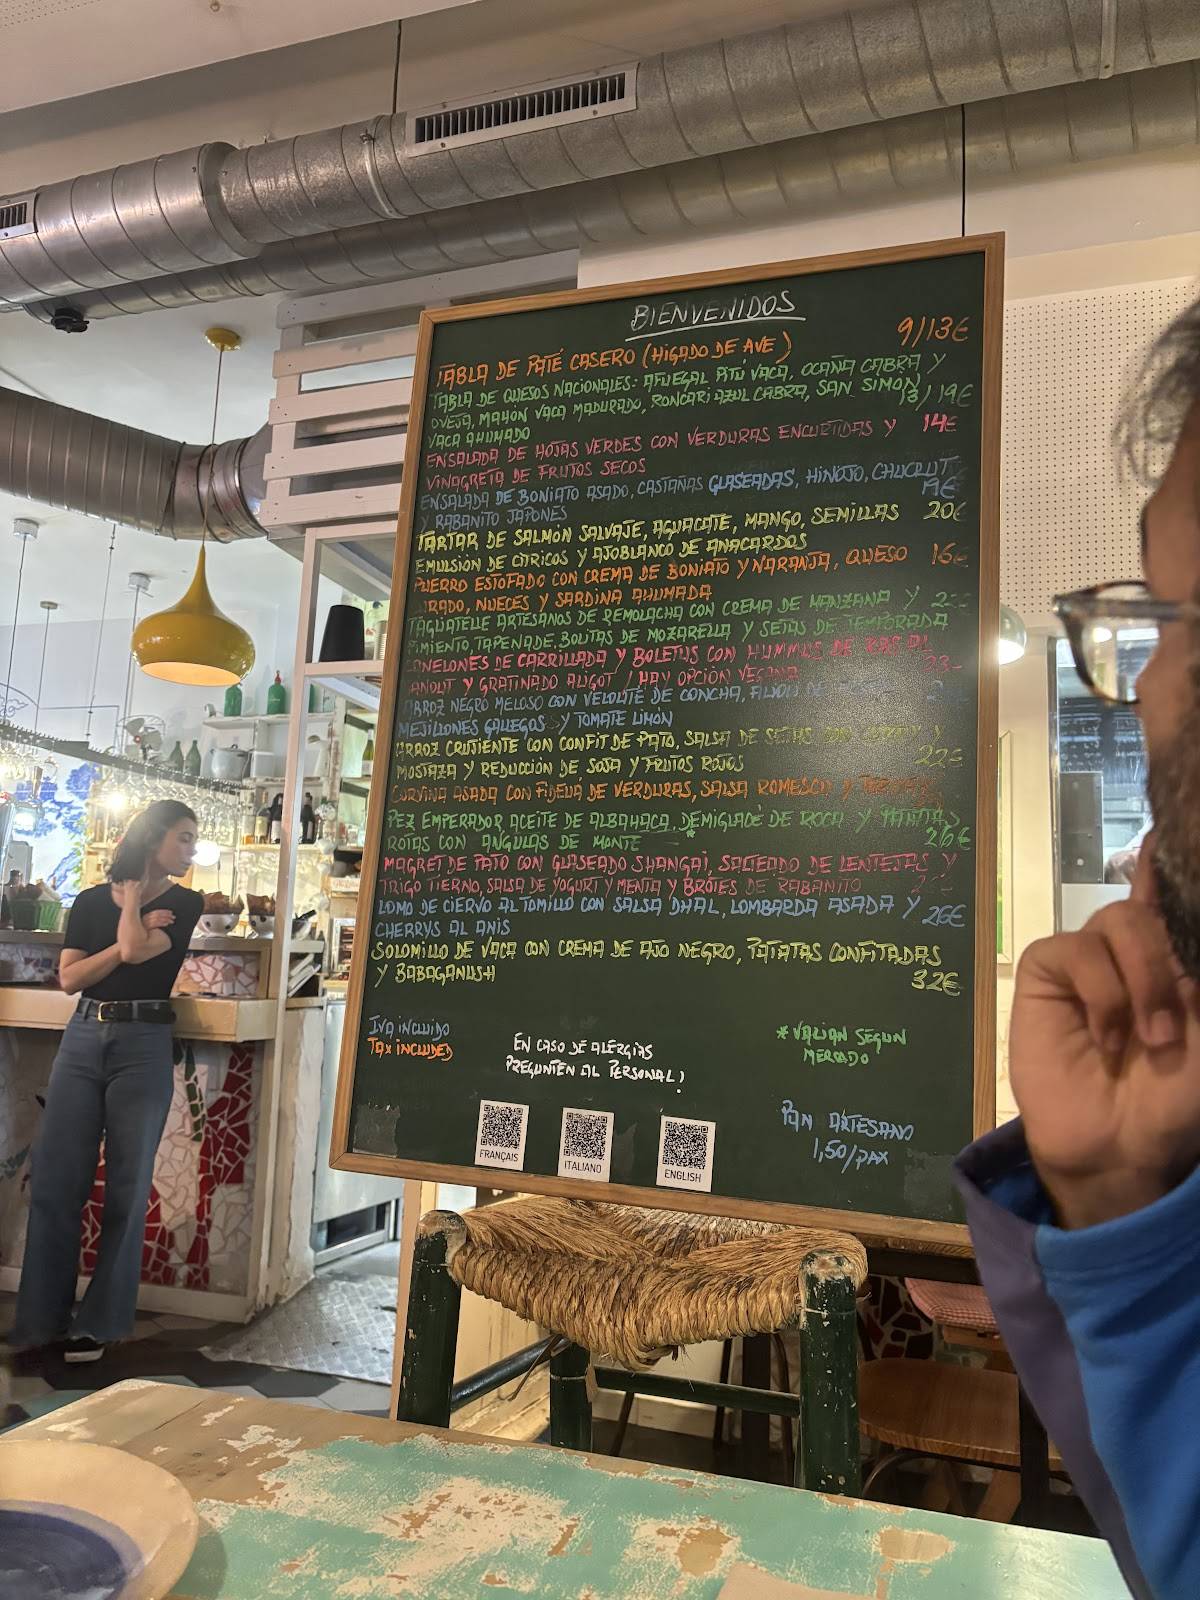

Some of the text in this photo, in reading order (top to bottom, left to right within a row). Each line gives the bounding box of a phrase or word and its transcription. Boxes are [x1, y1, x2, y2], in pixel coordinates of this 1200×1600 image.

[631, 290, 796, 331] BIENVENIDOS
[437, 364, 489, 390] TABLA
[496, 360, 520, 380] DE
[569, 349, 635, 371] CASERO
[711, 338, 740, 359] DE
[430, 391, 472, 413] TABLA
[476, 389, 499, 407] DE
[503, 384, 549, 402] QUESOS
[860, 353, 921, 376] CABRA
[927, 352, 946, 374] Y
[535, 403, 567, 420] VACA
[816, 379, 853, 397] SAN
[427, 426, 770, 469] ENSALADA DE HOJAS VERDES CON VERDURAS
[428, 427, 530, 450] VACA AHUMADO
[427, 458, 646, 492] VINAGRETA DE FRUTOS SECOS
[420, 492, 489, 511] ENSALADA
[495, 488, 516, 505] DE
[518, 485, 580, 505] BONIATO
[416, 530, 478, 553] TARTAR
[486, 530, 507, 549] DE
[811, 502, 900, 525] SEMILLAS
[435, 510, 499, 531] RABANITO
[487, 533, 807, 573] DE AJOBLANCO DE ANACARDOS
[414, 545, 908, 593] PUERRO ESTOFADO CON CREMA DE BONIATO QUESO
[476, 584, 713, 612] NUECES SARDINA AHUMADA
[497, 610, 572, 635] ARTESANOS
[577, 608, 598, 625] DE
[602, 605, 684, 626] REMOLACHA
[689, 602, 715, 618] CON
[722, 598, 773, 616] CREMA
[777, 595, 803, 613] DE
[559, 618, 806, 649] BOLITAS DE MOZARELLA SETAS
[494, 645, 736, 672] DE CARRILLADA BOLETUS CON
[479, 673, 558, 697] GRATINADO
[639, 671, 671, 690] HAY
[451, 687, 673, 718] NEGRO MELOSO CON DE
[400, 709, 626, 739] MEJILLONES GALLEGOS TOMATE
[445, 736, 519, 756] CRUJIENTE
[527, 737, 553, 752] CON
[559, 731, 611, 752] CONFIT
[611, 732, 635, 751] DE
[684, 730, 731, 749] SALSA
[397, 753, 744, 781] MOSTAZA DE SOJA FRUTOS ROJOS
[453, 780, 749, 805] ASADA CON DE SALSA
[421, 809, 794, 832] EMPERADOR ACEITE DE DE
[388, 833, 642, 854] ROTAS CON DE MONTE
[384, 854, 447, 878] MAGRET
[447, 856, 467, 874] DE
[474, 854, 509, 872] PATO
[517, 855, 543, 872] CON
[808, 855, 833, 875] DE
[379, 878, 421, 899] TRIGO
[487, 877, 525, 894] SALSA
[529, 877, 549, 895] DE
[617, 878, 661, 896] MENTA
[778, 876, 862, 896] RABANITO
[378, 894, 894, 918] LOMO DE CIERVO AL CON SALSA LOMBARDA ASADA
[375, 920, 441, 939] CHERRYS
[449, 920, 468, 937] AL
[371, 941, 448, 960] SOLOMILLO
[454, 940, 474, 960] DE
[481, 936, 517, 960] VACA
[525, 939, 549, 957] CON
[558, 939, 604, 959] CREMA
[610, 939, 634, 958] DE
[746, 937, 822, 964] PATATAS
[829, 940, 942, 966] CONFITADAS
[395, 962, 496, 986] BABAGANUSH
[537, 1039, 565, 1053] CASO
[803, 1048, 869, 1067] MERCADO
[506, 1055, 575, 1079] PREGUNTEN
[480, 1149, 519, 1163] FRANÇAIS
[564, 1160, 602, 1174] ITALIANO
[664, 1169, 702, 1183] ENGLISH
